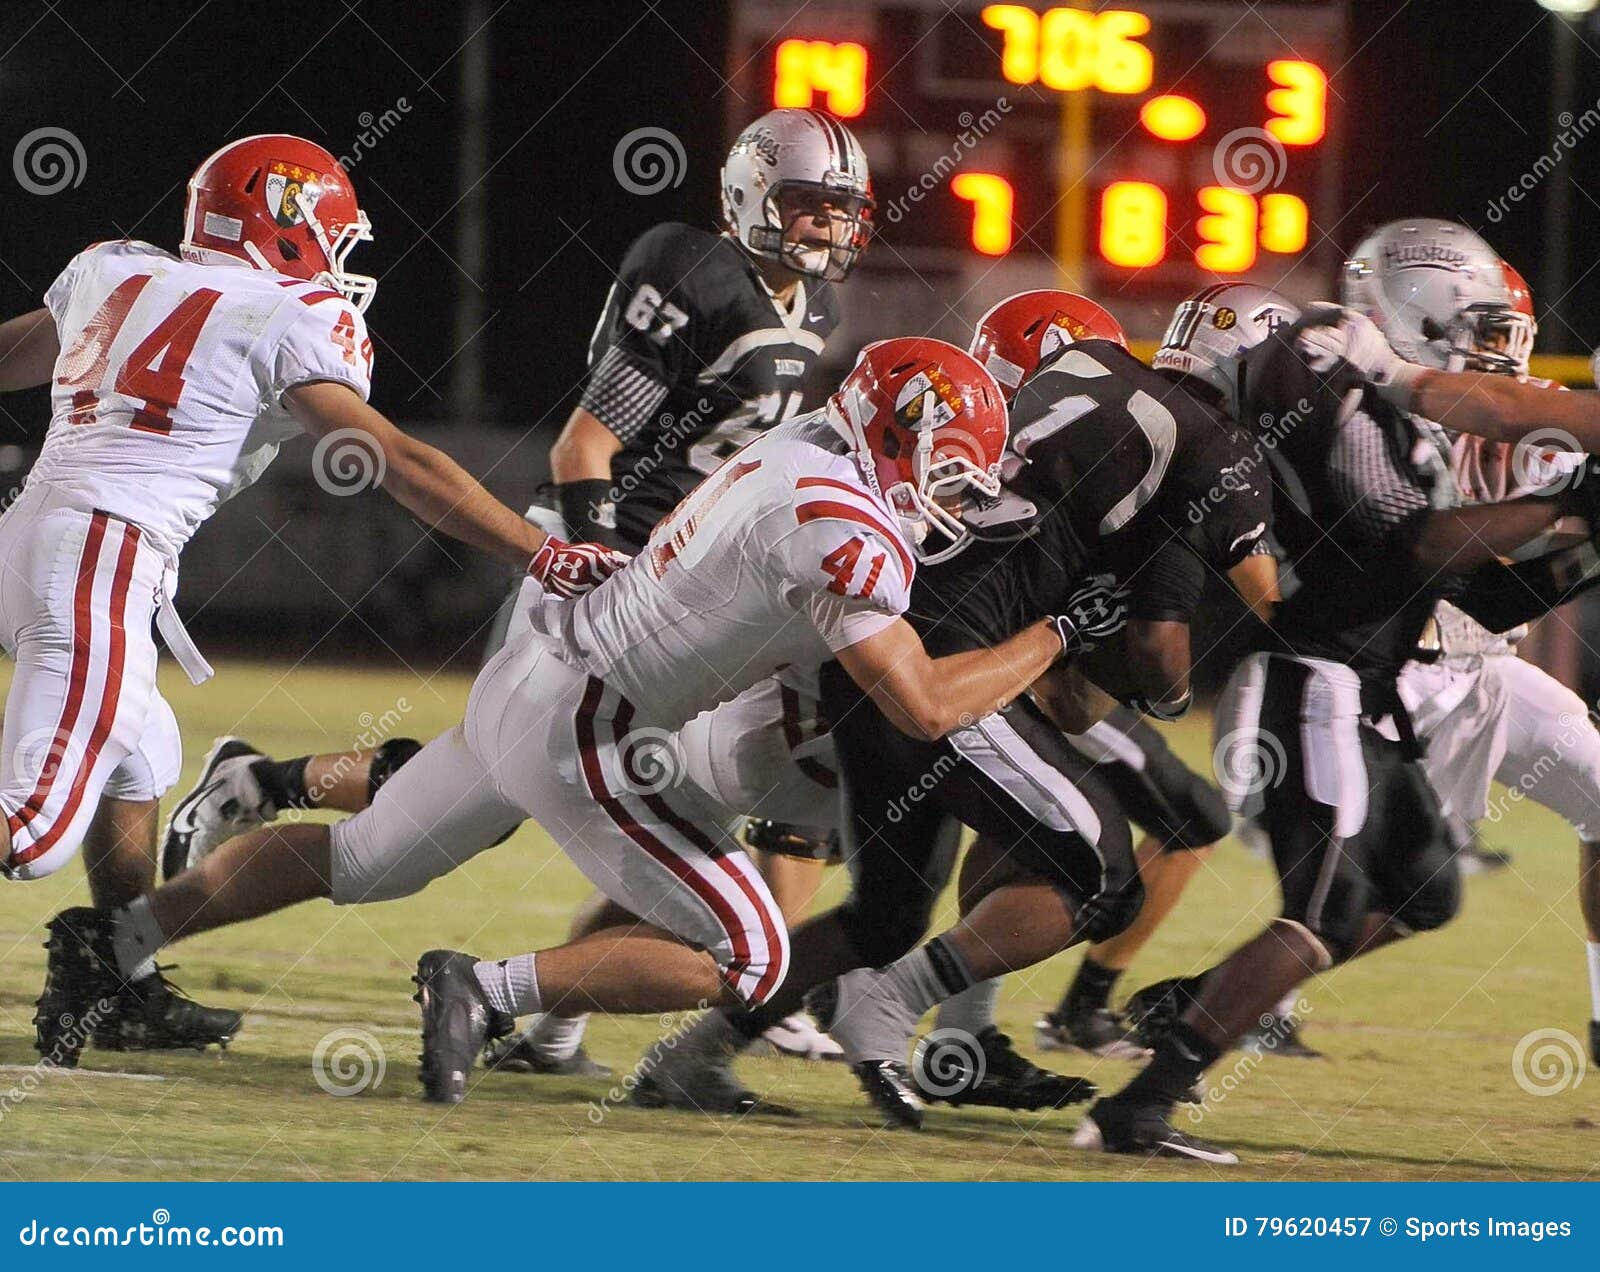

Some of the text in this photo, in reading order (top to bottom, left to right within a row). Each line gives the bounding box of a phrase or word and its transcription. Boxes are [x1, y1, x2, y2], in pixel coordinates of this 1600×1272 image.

[774, 39, 868, 118] 14
[982, 4, 1154, 94] 706
[1263, 59, 1328, 147] 3
[951, 172, 1014, 256] 7
[1100, 180, 1168, 269] 8
[1194, 184, 1259, 274] 3
[57, 273, 224, 436] 44
[625, 283, 689, 346] 67
[820, 536, 886, 599] 41
